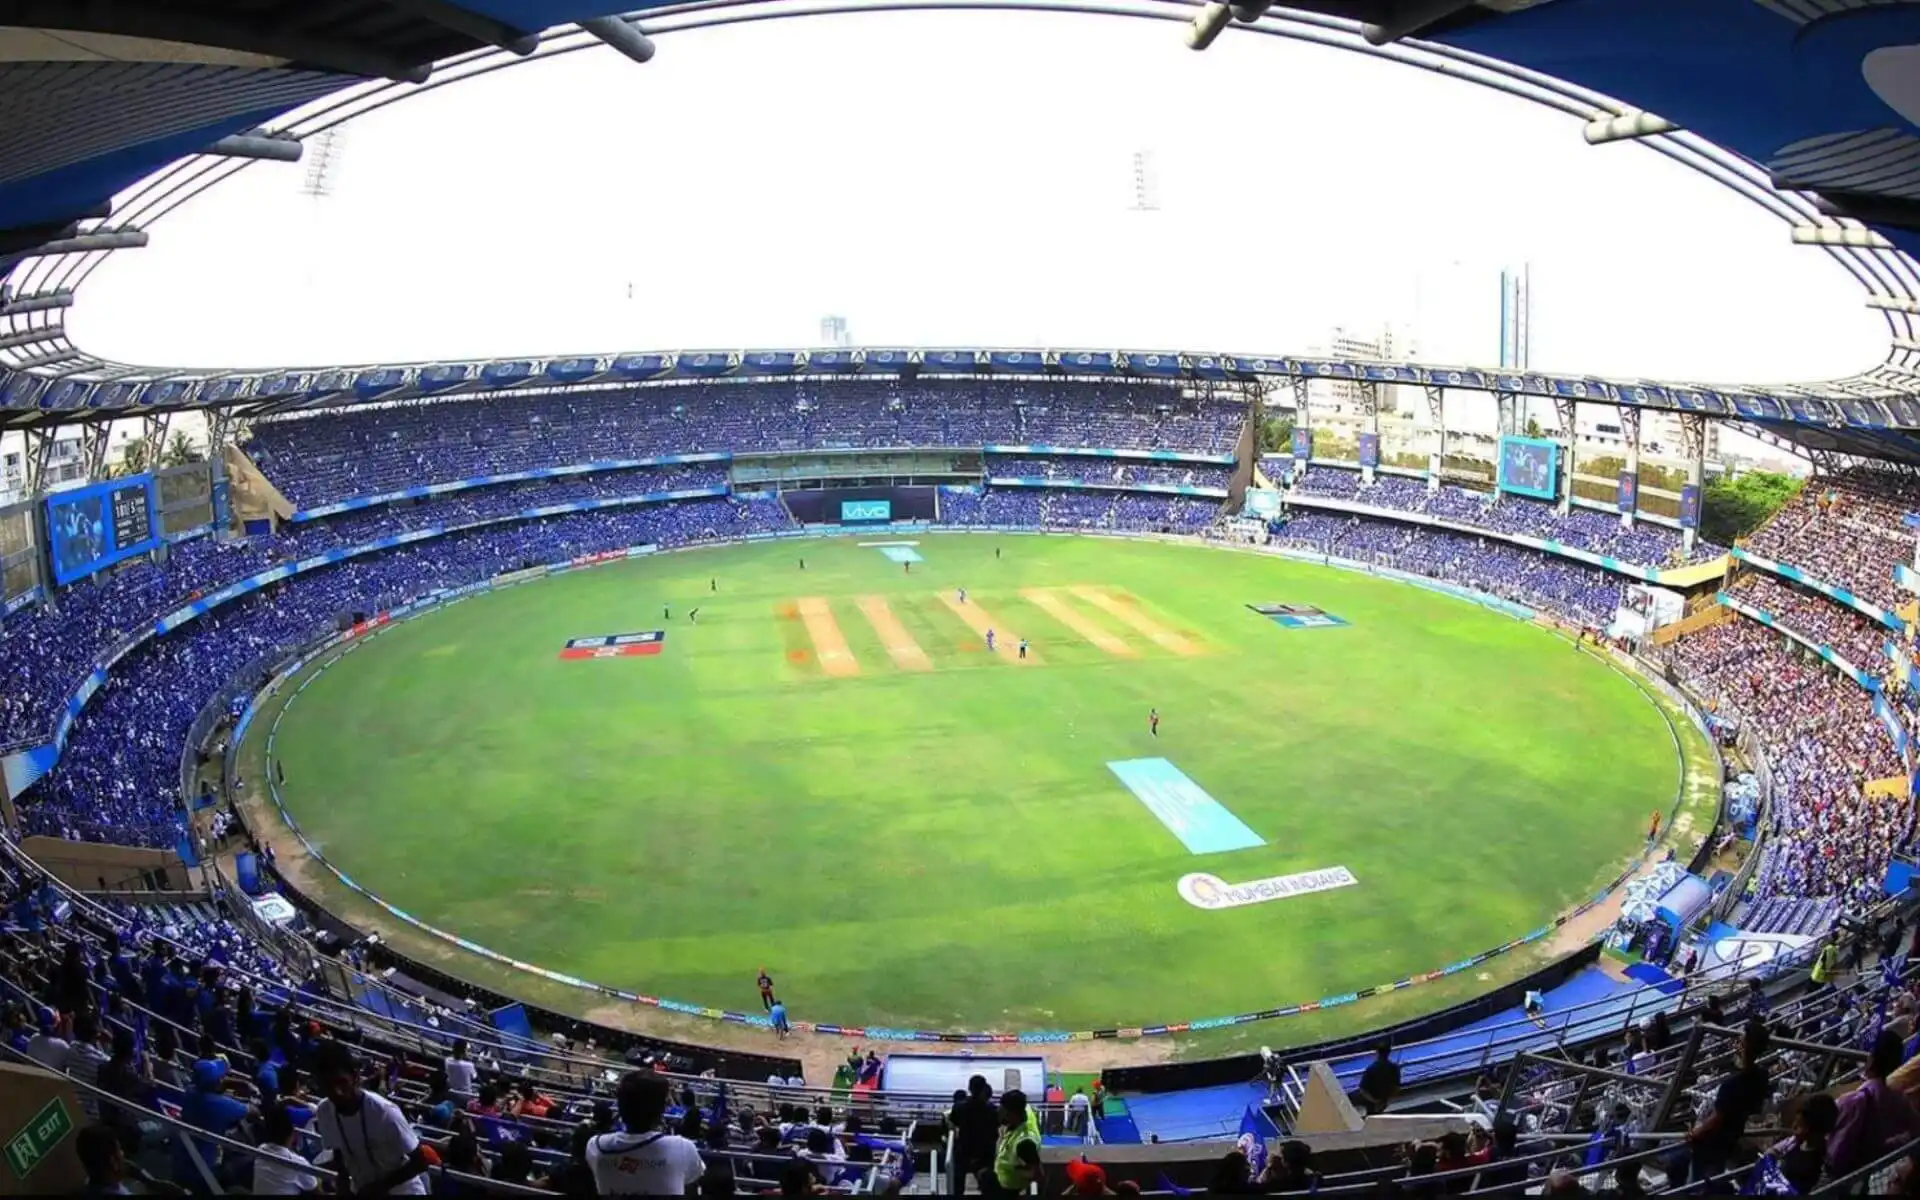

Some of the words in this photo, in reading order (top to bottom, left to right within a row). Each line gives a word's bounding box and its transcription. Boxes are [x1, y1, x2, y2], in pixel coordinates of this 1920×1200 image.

[1224, 879, 1291, 902] MUMBAI
[1291, 868, 1350, 890] INDIANS
[38, 1111, 61, 1141] EXIT
